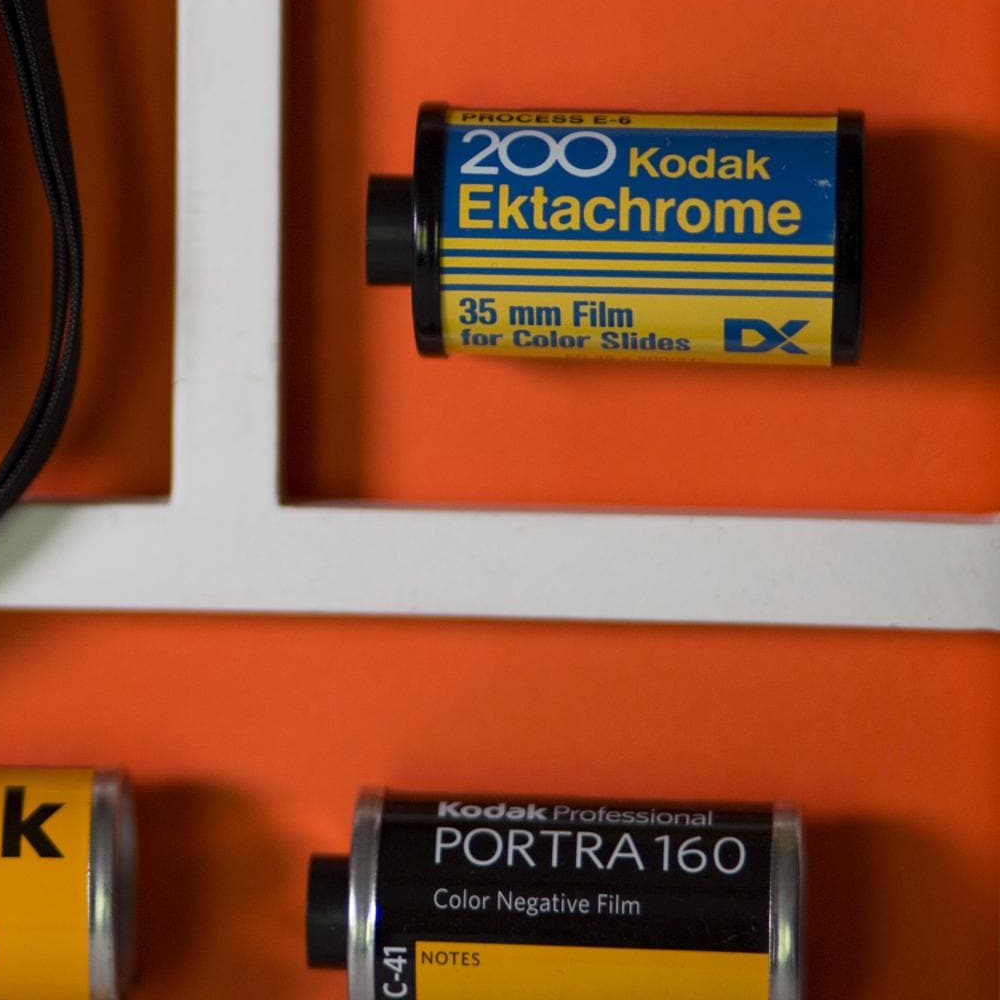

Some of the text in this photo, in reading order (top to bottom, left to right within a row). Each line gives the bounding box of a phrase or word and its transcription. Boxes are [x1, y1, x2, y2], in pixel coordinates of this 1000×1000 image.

[461, 112, 632, 125] PROCESS E-6
[460, 129, 771, 180] 200 Kodak
[458, 183, 802, 236] Ektachrome
[458, 297, 634, 328] 35 mm Film
[460, 329, 690, 352] for Color Slides
[723, 318, 809, 355] DX
[437, 800, 713, 826] Kodak Professional
[434, 826, 747, 874] PORTRA 160
[433, 887, 641, 917] Color Negative Film
[382, 946, 409, 998] C-41
[421, 951, 481, 967] NOTES
